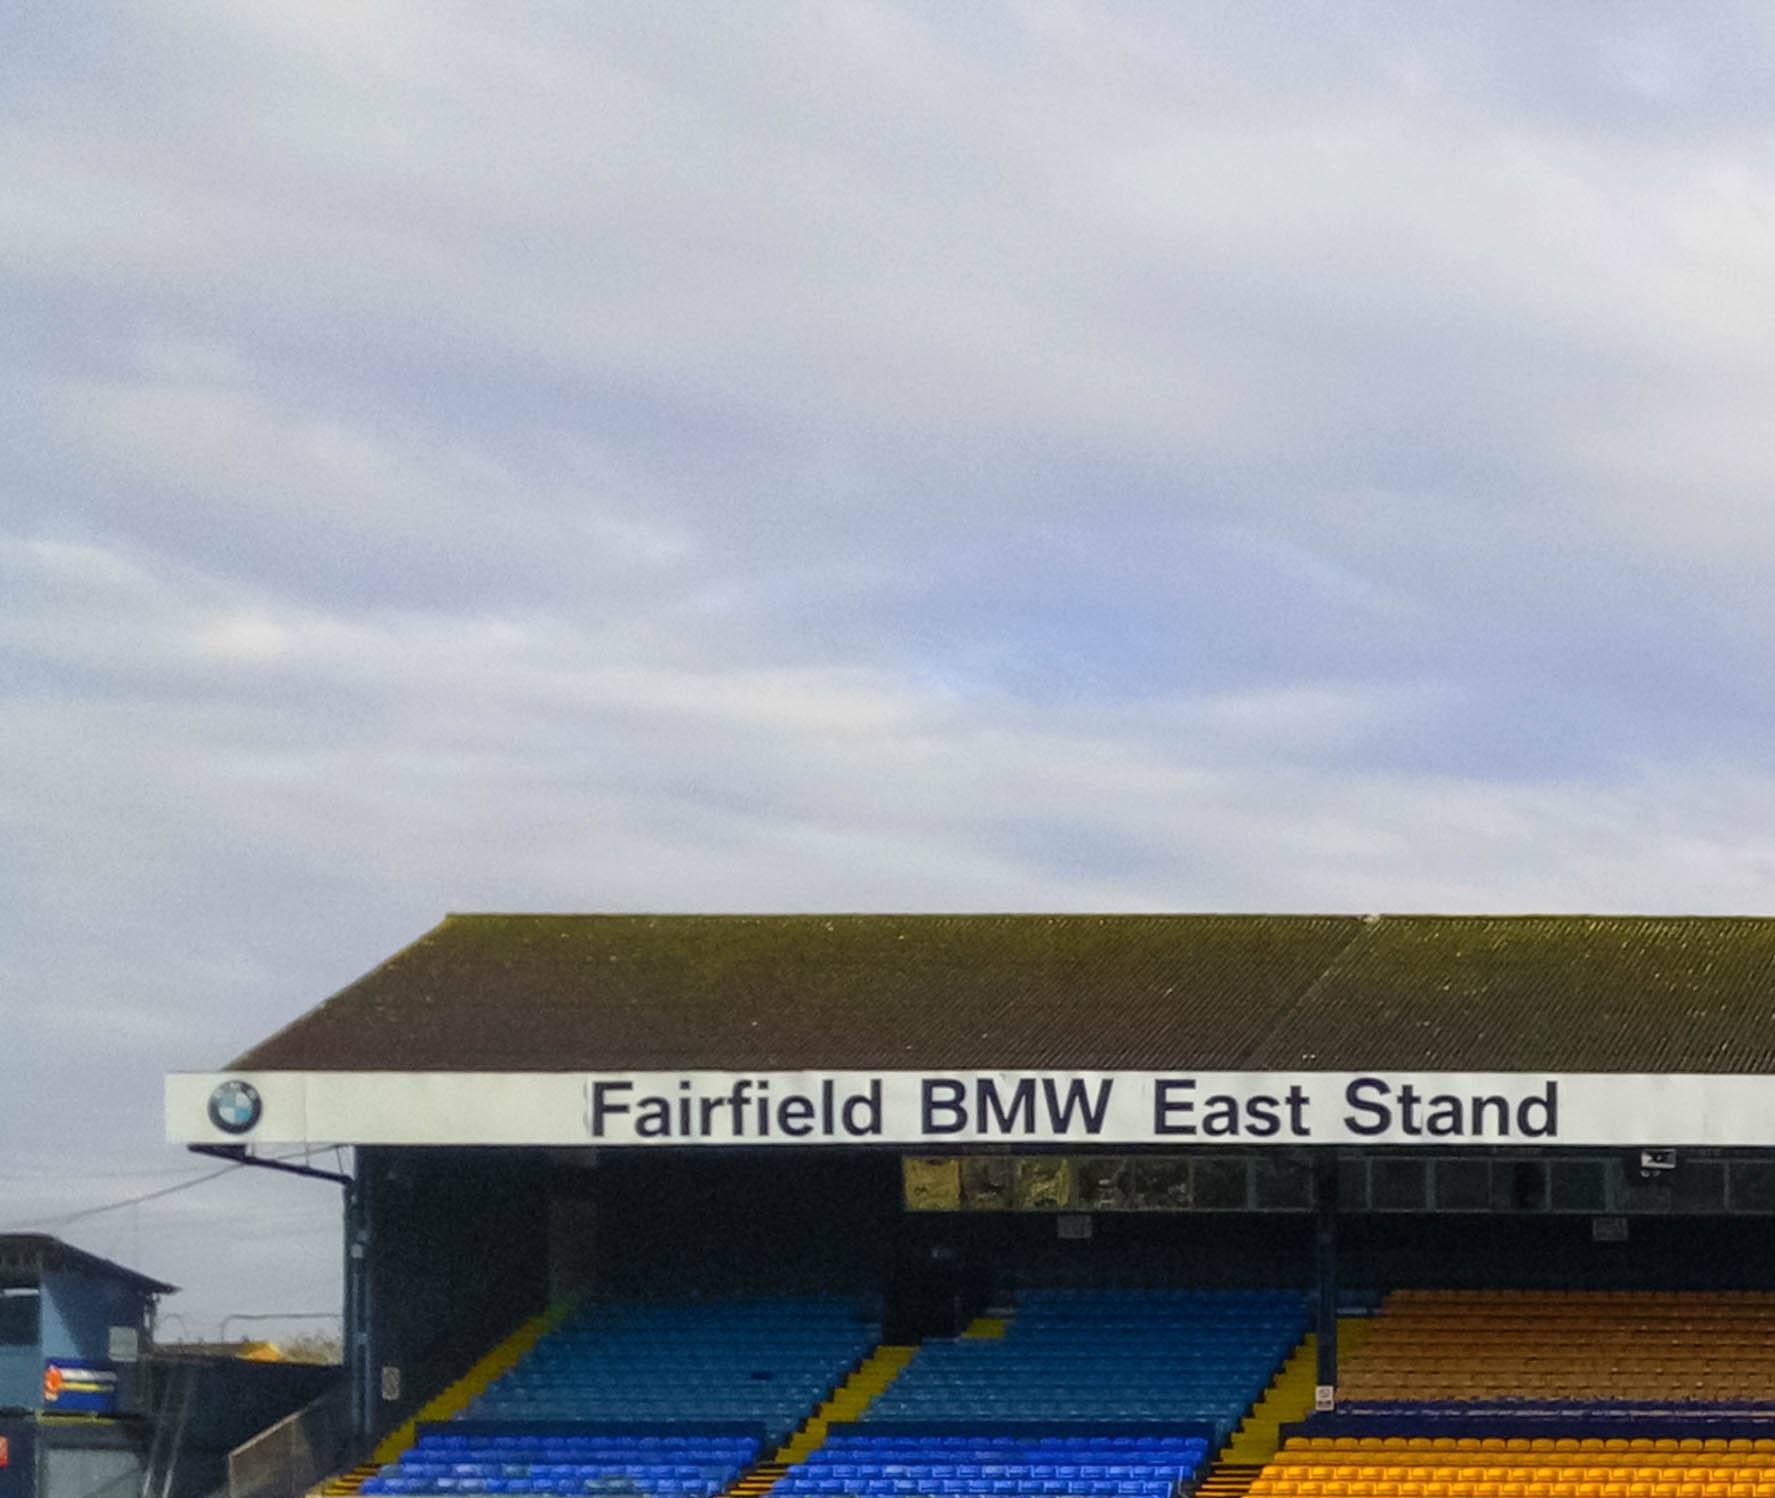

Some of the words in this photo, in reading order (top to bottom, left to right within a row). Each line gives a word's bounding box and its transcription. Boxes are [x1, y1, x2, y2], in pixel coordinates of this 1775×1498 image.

[591, 1079, 882, 1138] Fairfield
[920, 1078, 1115, 1135] BMW
[1153, 1079, 1311, 1137] East
[1342, 1077, 1558, 1138] Stand
